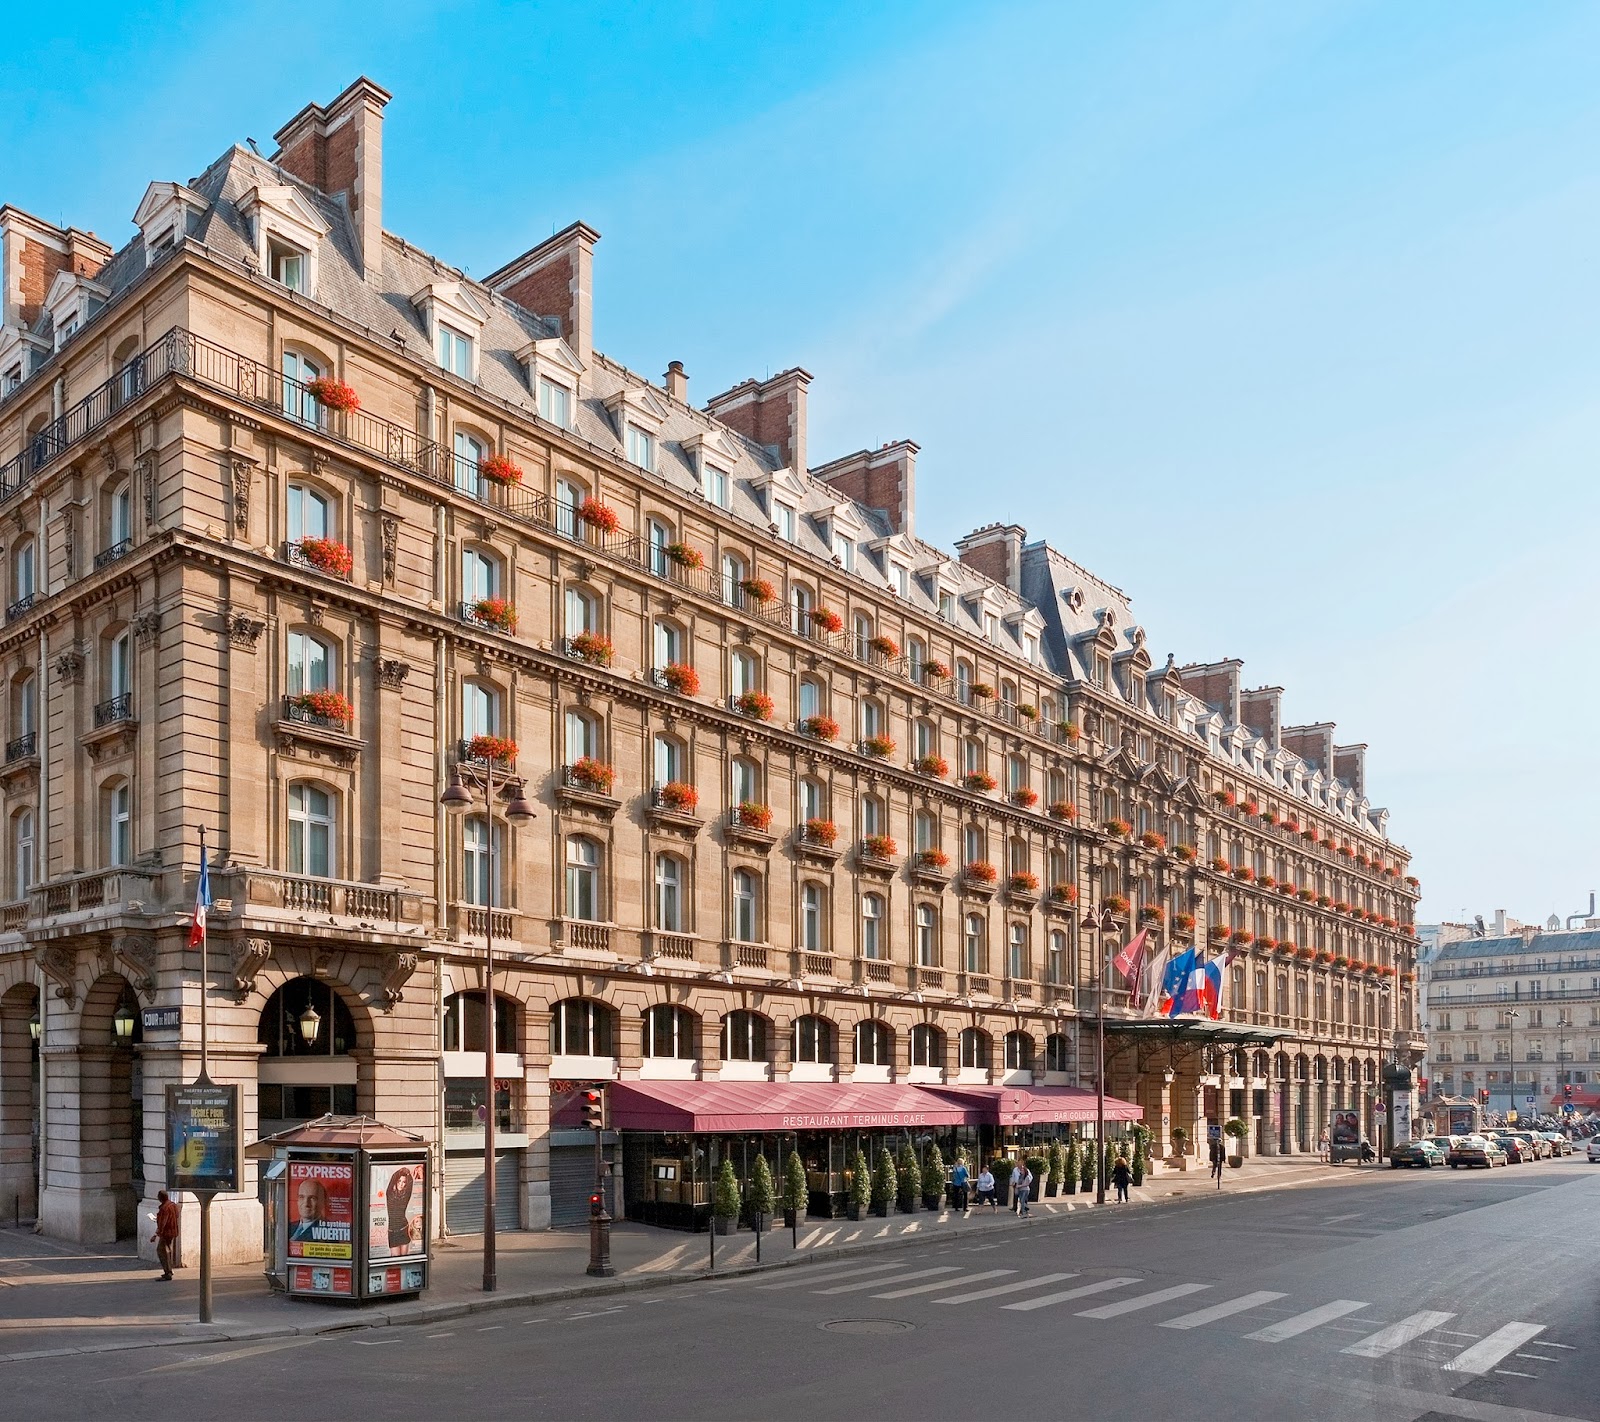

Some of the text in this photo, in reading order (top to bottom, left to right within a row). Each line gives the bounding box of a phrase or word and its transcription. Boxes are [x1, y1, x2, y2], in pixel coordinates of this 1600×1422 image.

[145, 1014, 159, 1027] COUR
[164, 1012, 179, 1025] ROME
[783, 1114, 926, 1126] RESTAURANT TERMINUS CAFE
[1054, 1112, 1067, 1120] BAR
[1069, 1111, 1094, 1120] GOLDEN
[291, 1165, 352, 1179] L'EXPRESS
[326, 1221, 350, 1229] système
[311, 1227, 351, 1241] WOERTH
